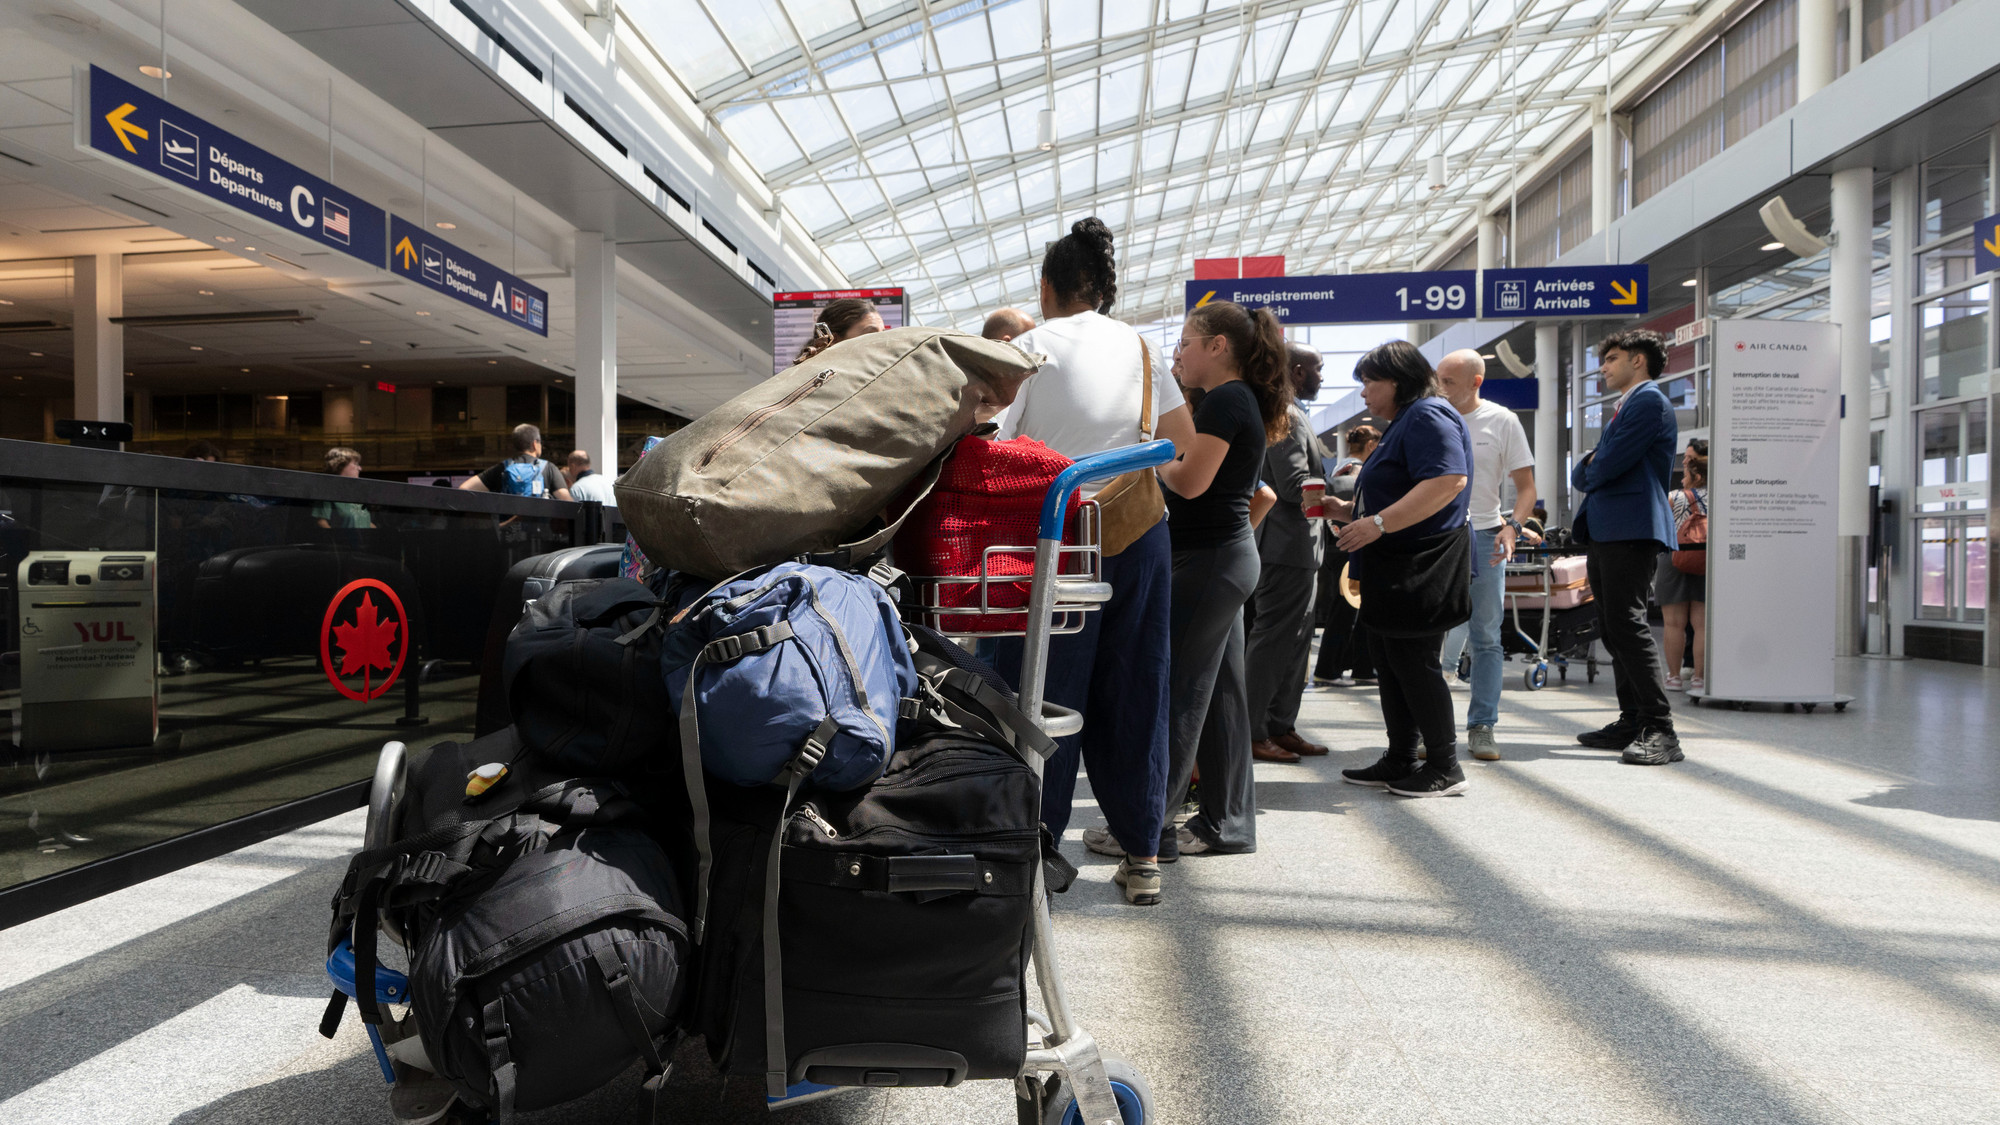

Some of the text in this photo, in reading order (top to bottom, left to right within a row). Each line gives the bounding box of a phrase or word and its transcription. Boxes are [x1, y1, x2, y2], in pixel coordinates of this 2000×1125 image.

[209, 145, 264, 184] Départs
[209, 167, 283, 213] Departures
[290, 185, 315, 228] C
[446, 257, 477, 282] Départs
[446, 273, 487, 302] Departures
[491, 280, 508, 314] A
[1233, 289, 1335, 304] Enregistrement
[1533, 279, 1595, 293] Arrivées
[1395, 285, 1466, 312] 1-99
[1533, 296, 1591, 310] Arrivals
[1769, 343, 1808, 351] CANADA
[73, 621, 135, 643] YUL
[47, 660, 135, 669] International Airport
[55, 653, 135, 662] Montréal-Trudeau
